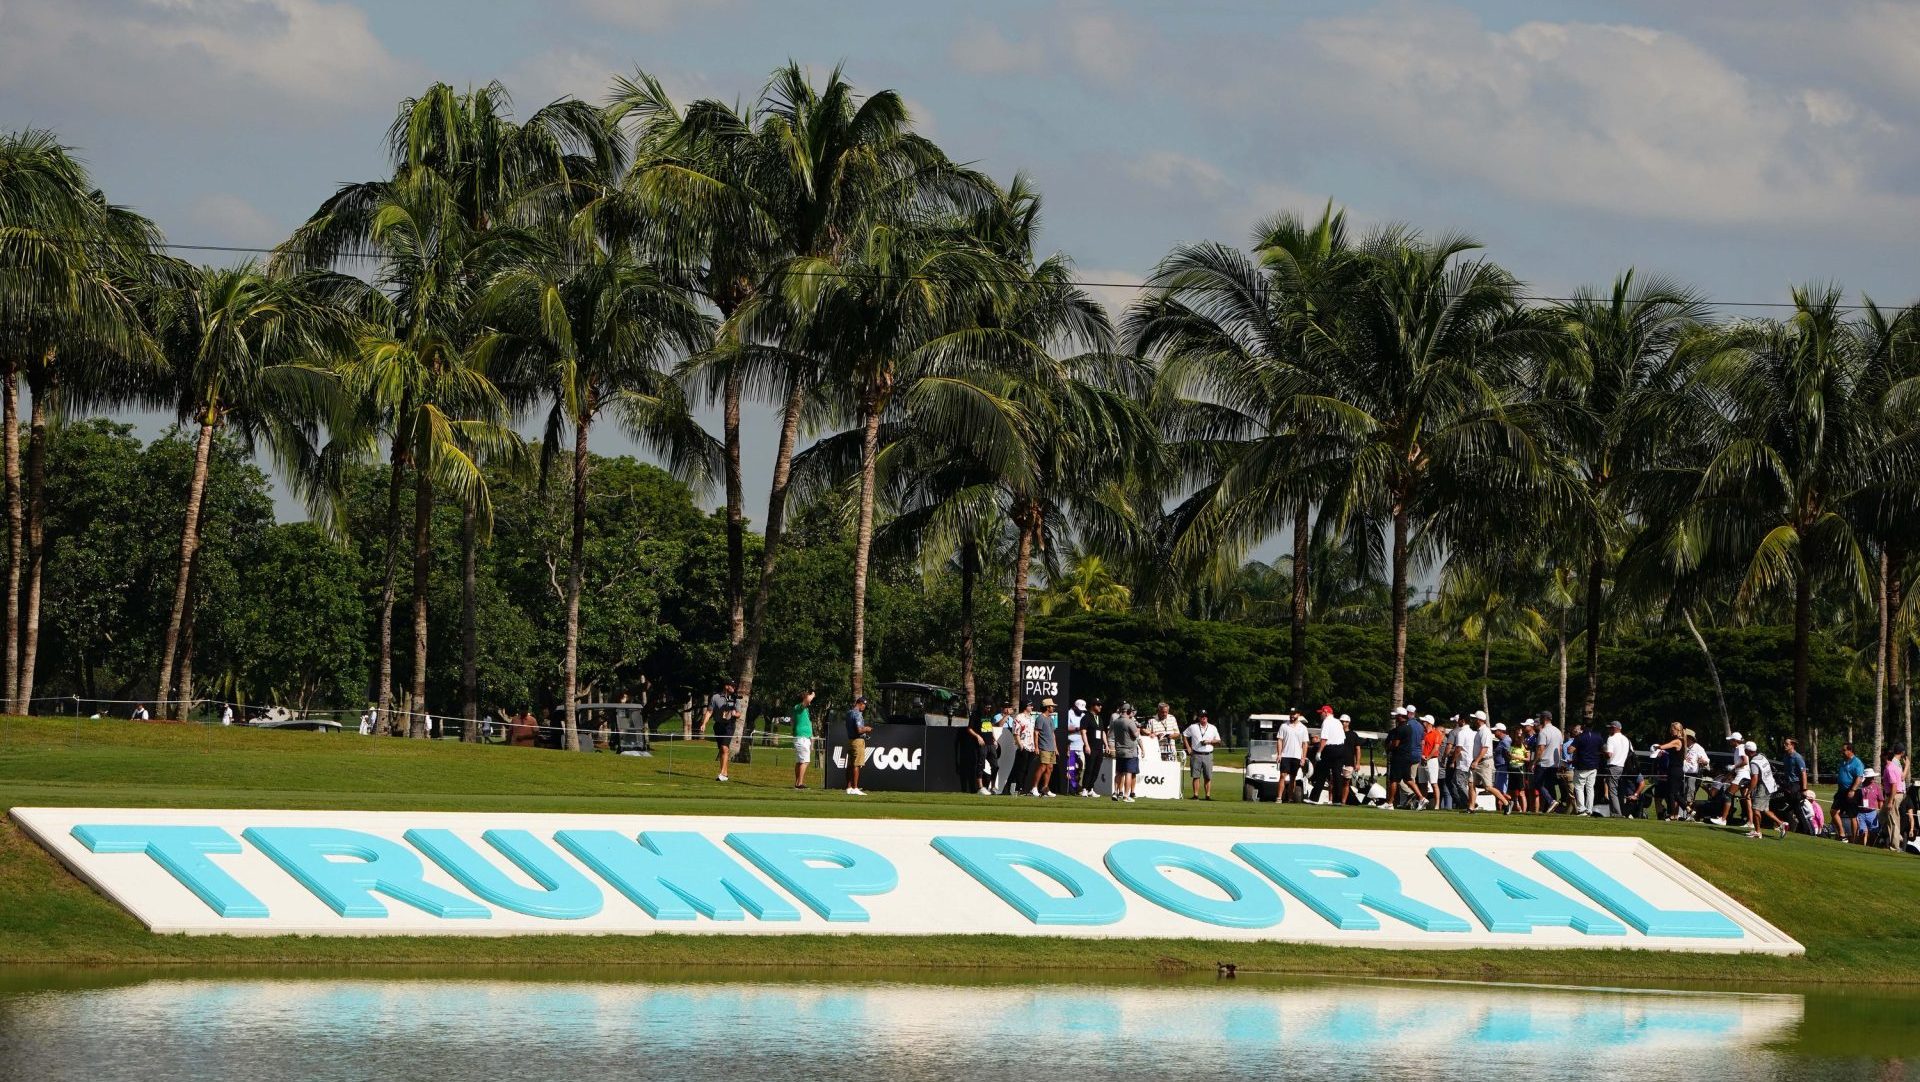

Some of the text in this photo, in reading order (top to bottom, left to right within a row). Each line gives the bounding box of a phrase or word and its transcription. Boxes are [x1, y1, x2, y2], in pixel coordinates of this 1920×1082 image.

[873, 746, 922, 770] GOLF
[1144, 775, 1164, 785] GOLF
[70, 824, 1744, 938] TRUMP DORAL
